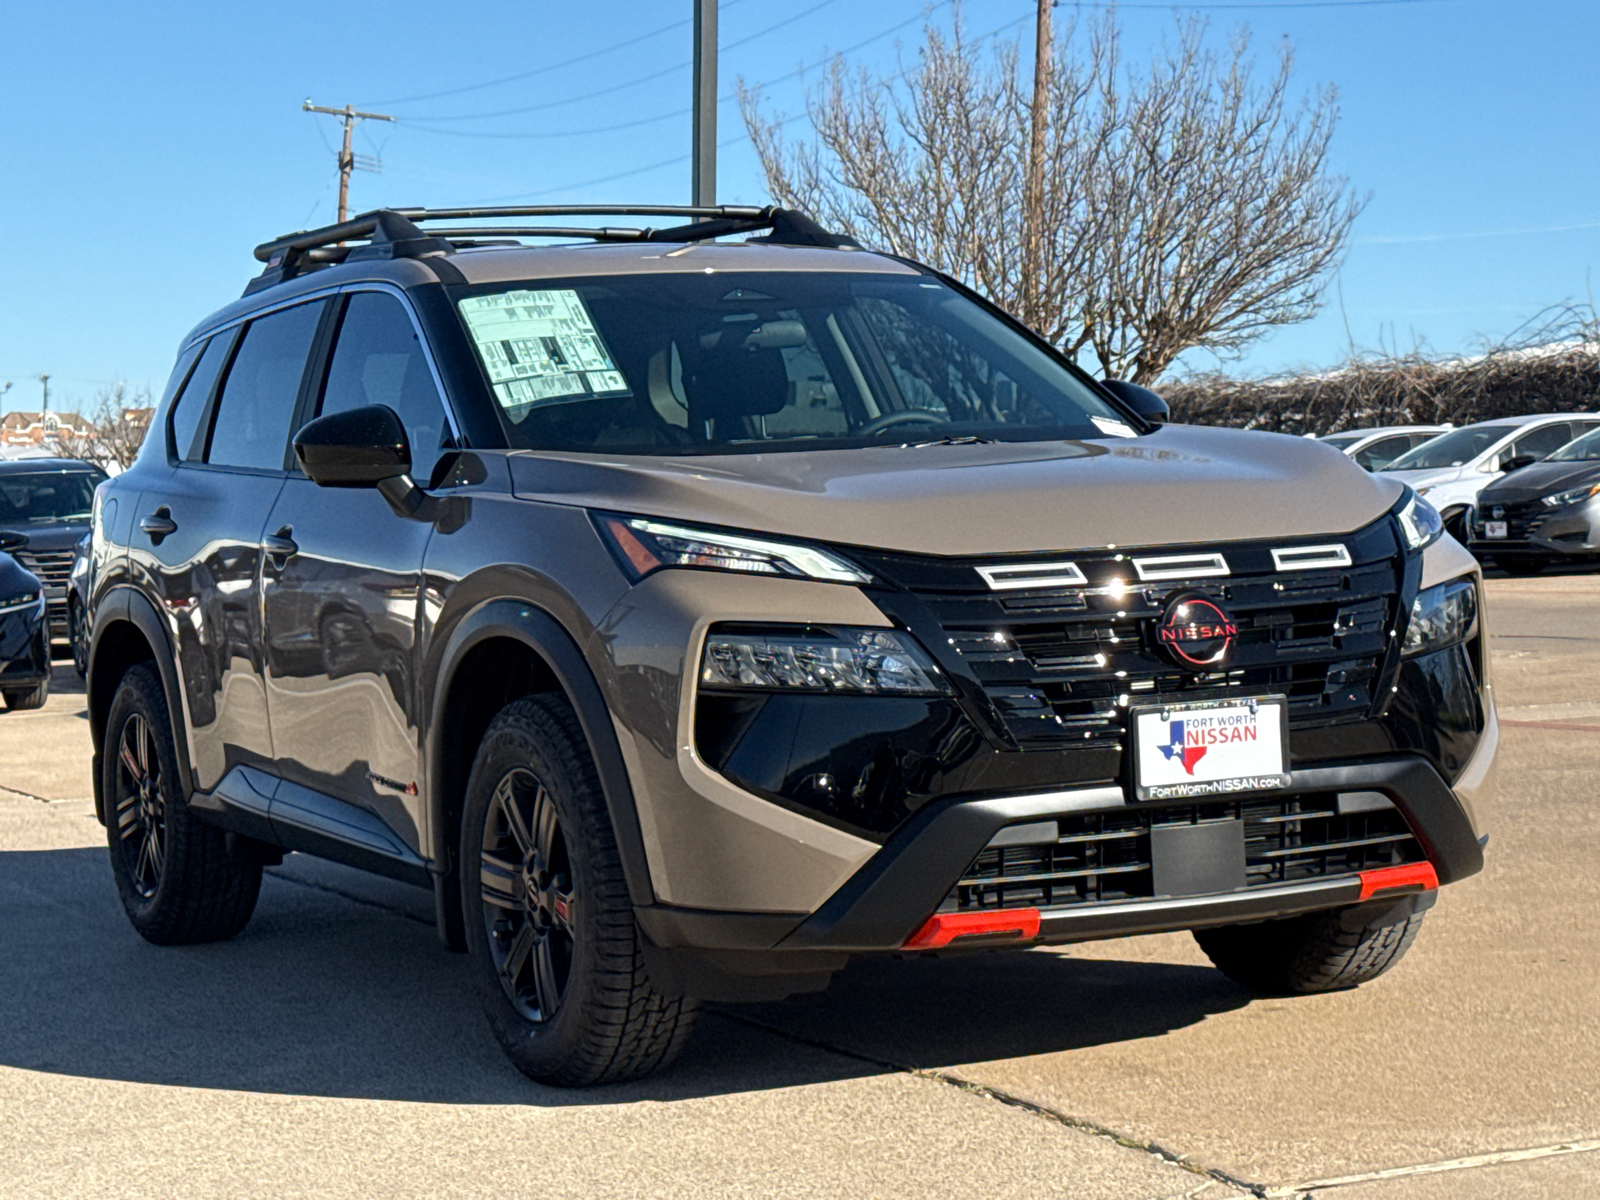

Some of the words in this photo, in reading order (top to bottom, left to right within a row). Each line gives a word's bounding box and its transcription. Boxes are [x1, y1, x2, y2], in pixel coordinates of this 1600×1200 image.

[1162, 624, 1237, 640] NISSAN
[1186, 717, 1214, 728] FORT
[1217, 714, 1256, 726] WORTH
[1187, 725, 1257, 746] NISSAN
